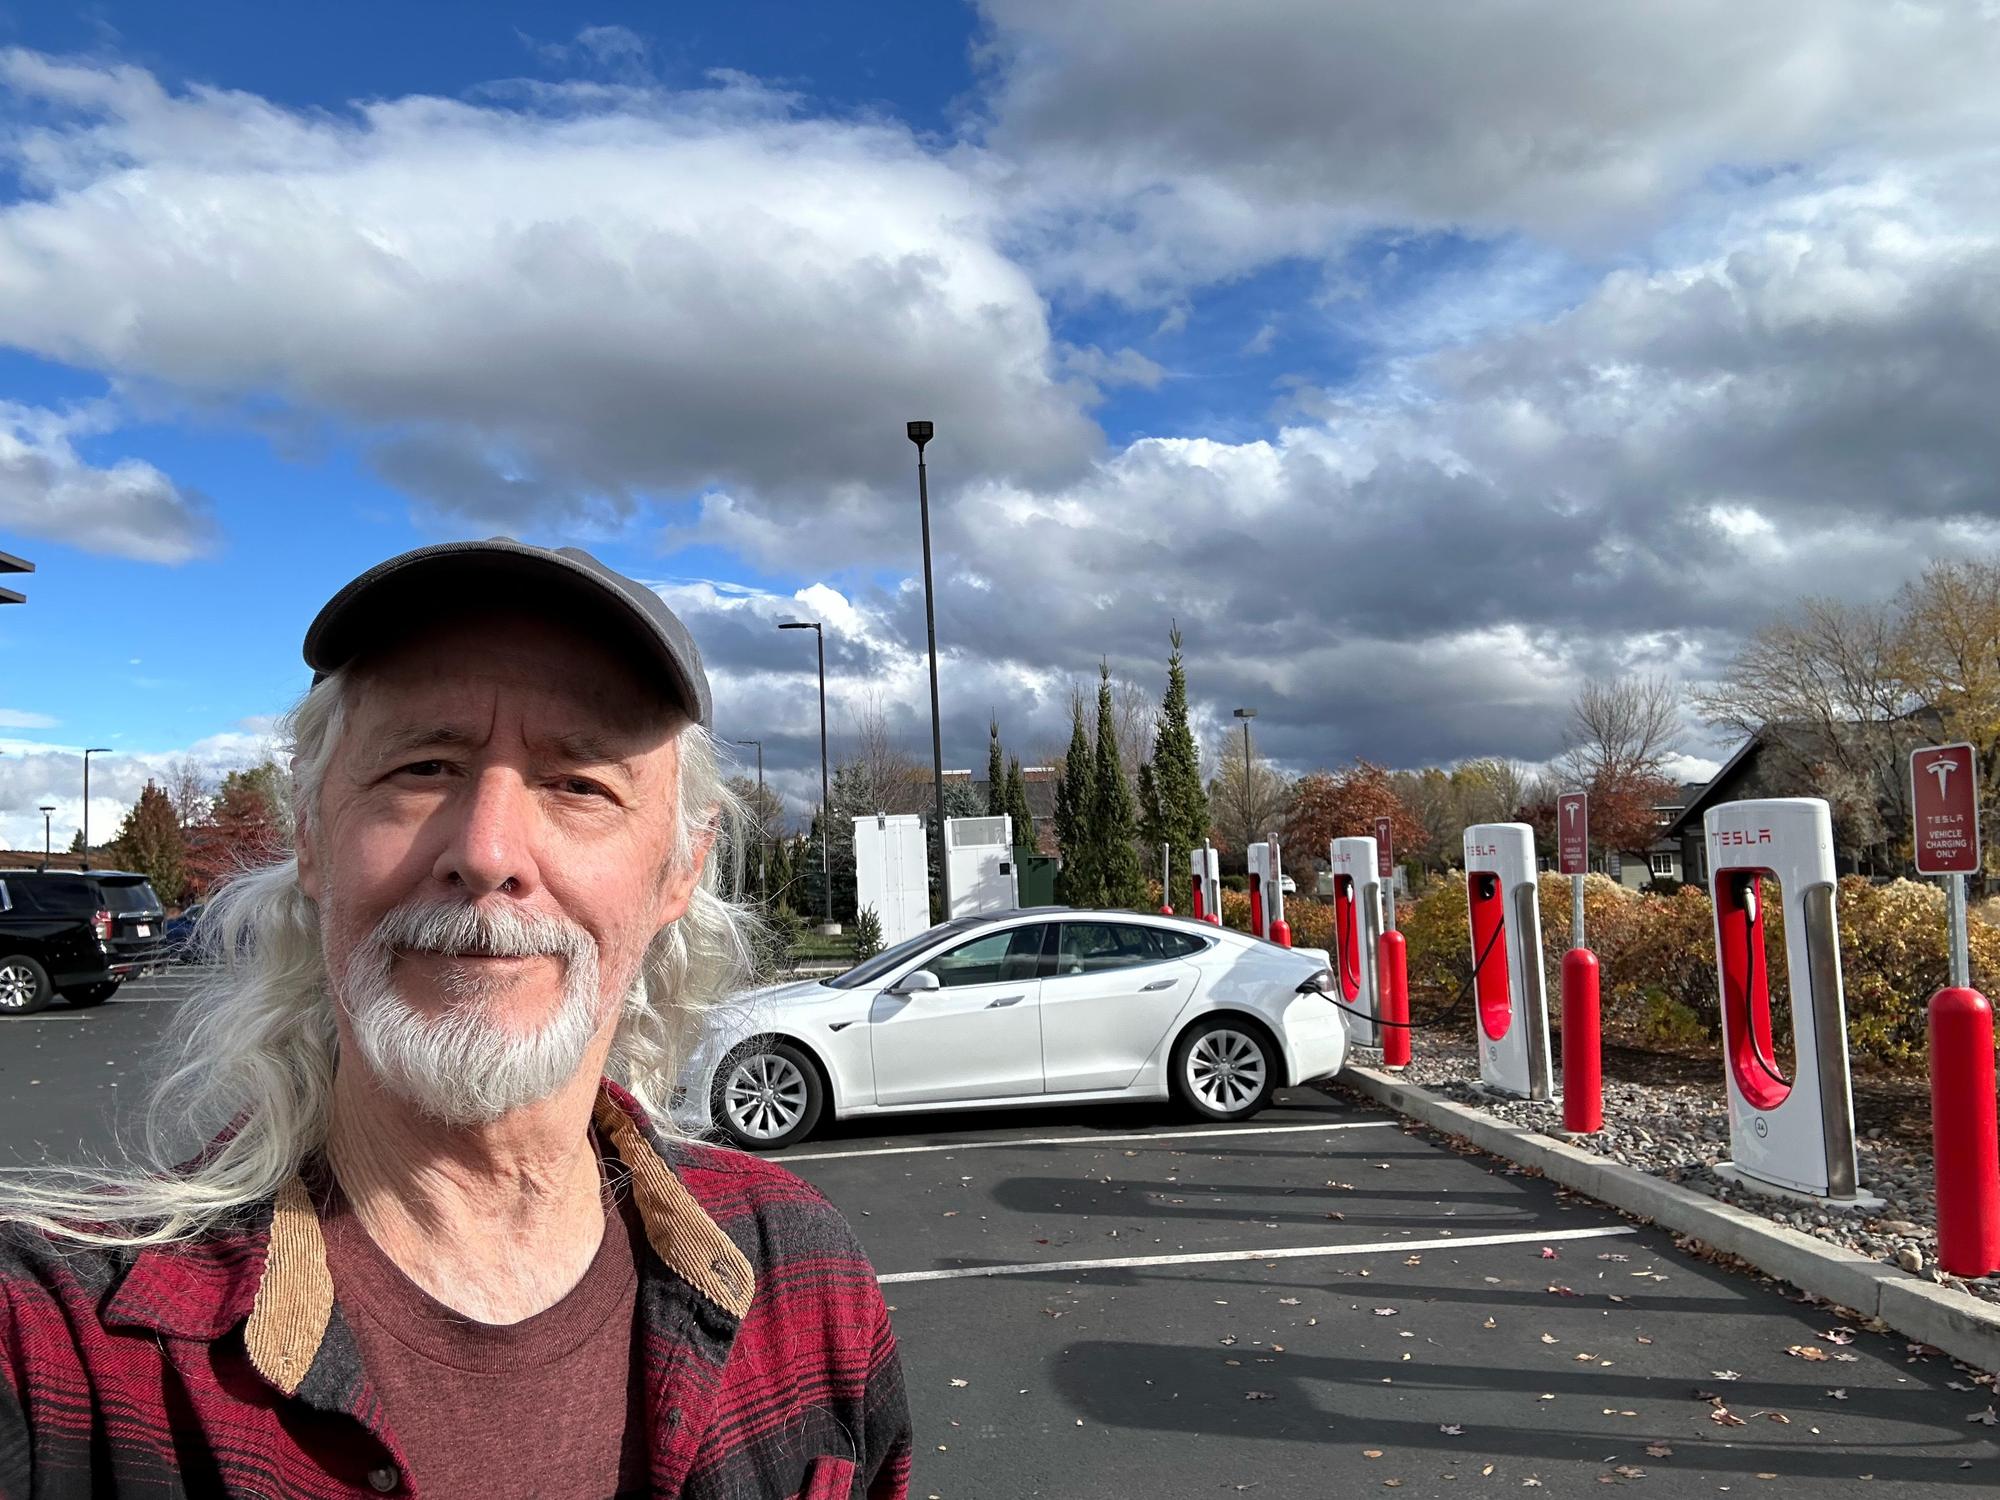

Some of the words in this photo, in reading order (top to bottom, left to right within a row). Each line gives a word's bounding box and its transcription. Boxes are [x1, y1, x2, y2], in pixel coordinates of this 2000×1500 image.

[1927, 814, 1964, 824] TESLA
[1712, 829, 1771, 846] TESLA
[1929, 829, 1962, 839] VEHICLE
[1926, 839, 1967, 849] CHARGING
[1936, 849, 1957, 858] ONLY
